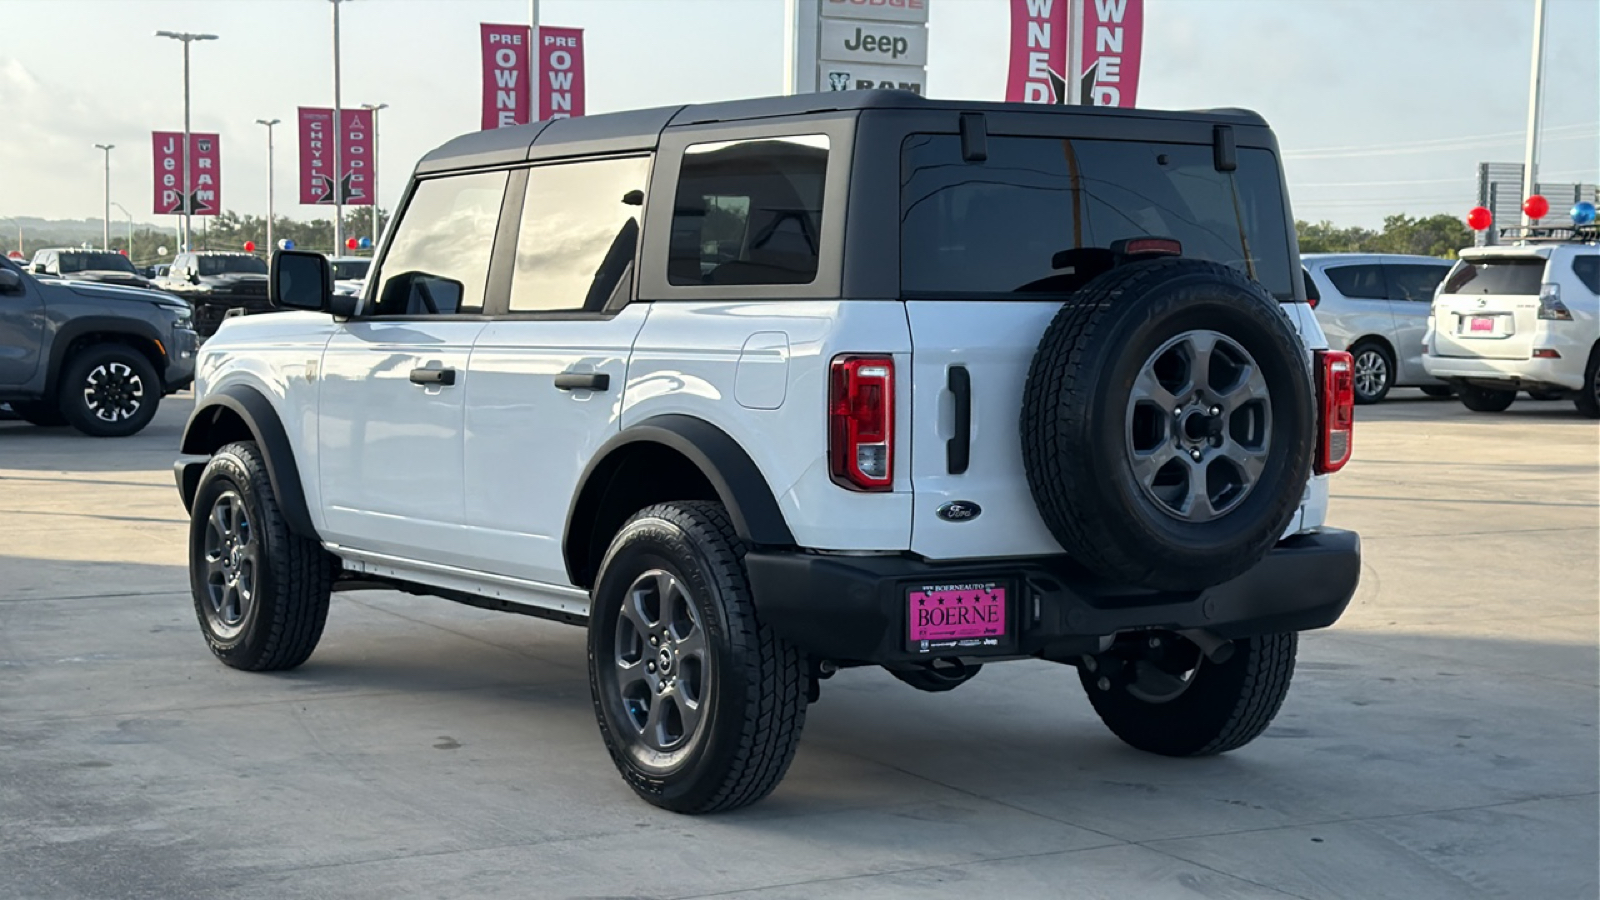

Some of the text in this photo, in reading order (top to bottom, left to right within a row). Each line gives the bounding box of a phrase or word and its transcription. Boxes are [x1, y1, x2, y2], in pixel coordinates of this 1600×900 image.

[489, 33, 522, 45] PRE
[544, 35, 577, 47] PRE
[844, 27, 908, 59] Jeep
[548, 50, 573, 120] OWN
[163, 137, 176, 207] Jeep
[198, 158, 214, 201] RAM
[310, 122, 322, 195] CHRYSLER
[350, 131, 365, 196] DODGE
[918, 604, 1000, 627] BOERNE
